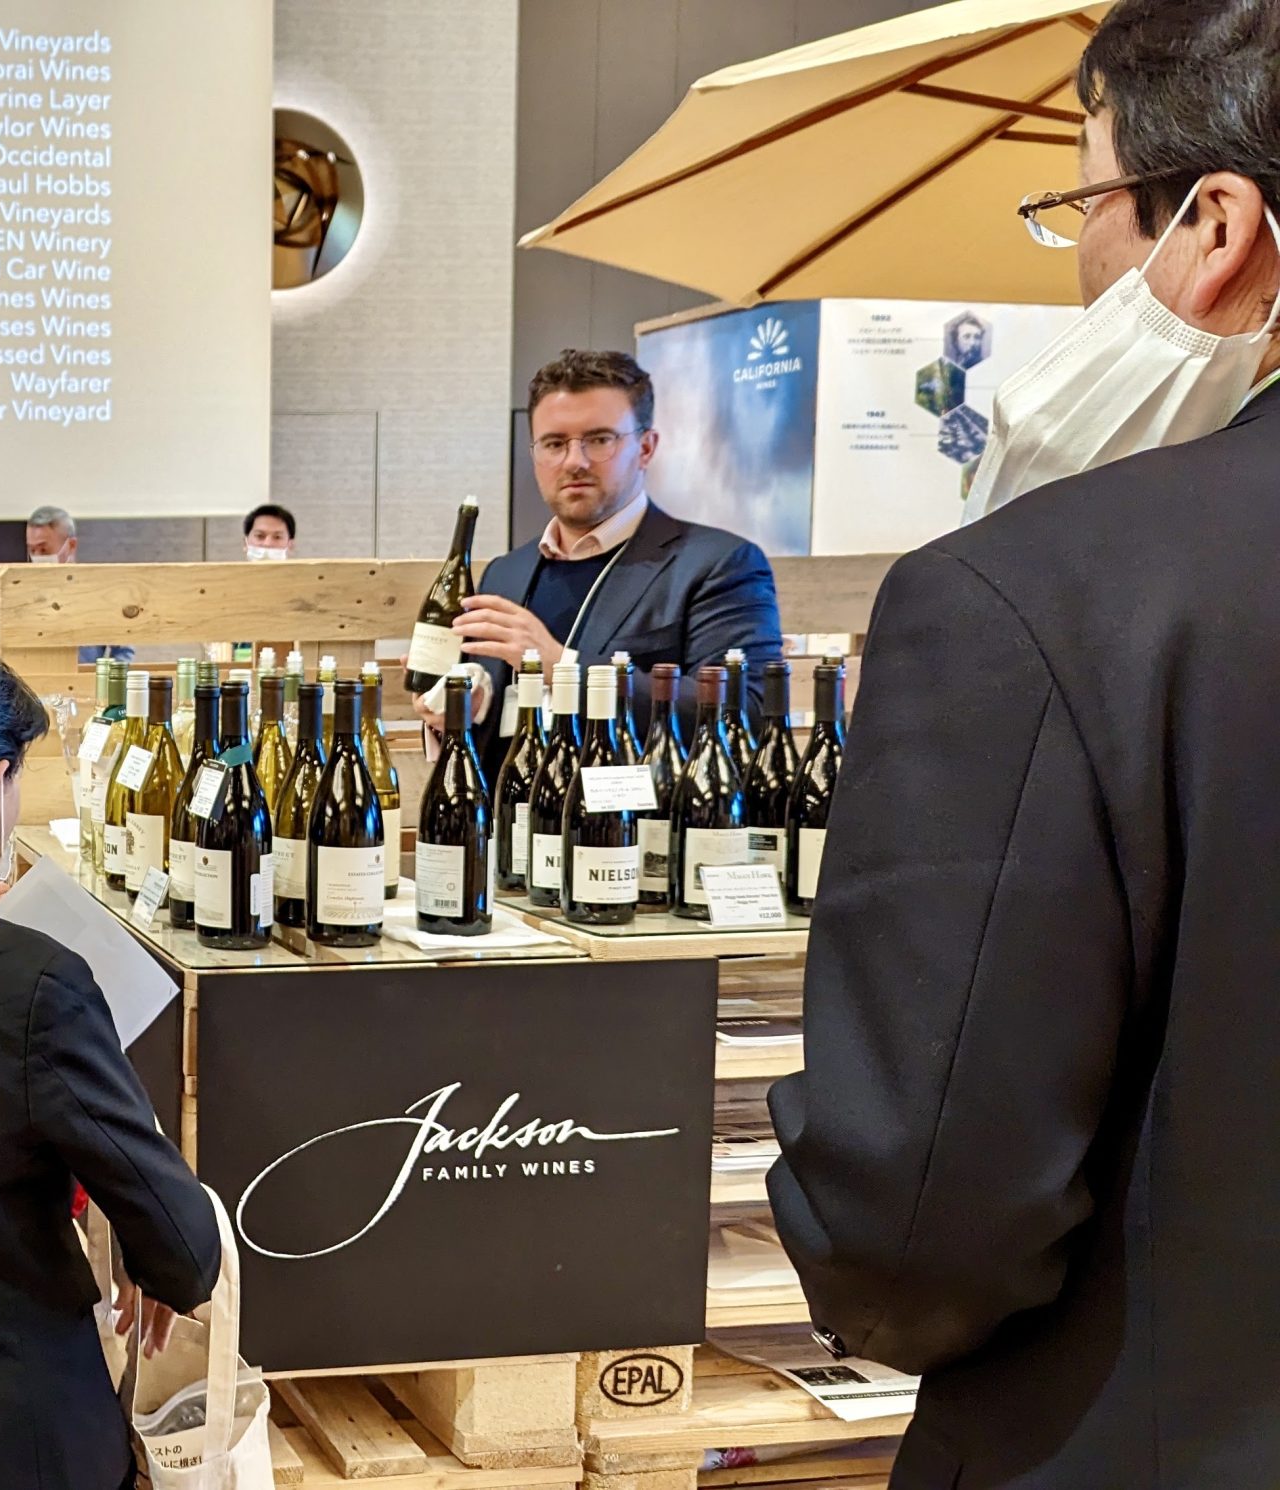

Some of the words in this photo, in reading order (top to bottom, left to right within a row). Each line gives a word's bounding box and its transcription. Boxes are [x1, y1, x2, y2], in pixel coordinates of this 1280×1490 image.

[40, 58, 111, 81] Wines
[49, 89, 110, 115] Layer
[41, 117, 111, 138] Wines
[35, 176, 111, 196] Hobbs
[0, 202, 111, 228] Vineyards
[31, 231, 111, 256] Winery
[6, 259, 45, 280] Car
[52, 261, 111, 280] Wine
[42, 288, 110, 308] Wines
[43, 316, 111, 337] Wines
[50, 345, 111, 366] Vines
[733, 357, 802, 383] CALIFORNIA
[11, 371, 111, 399] Wayfarer
[12, 400, 112, 426] Vineyard
[236, 1082, 680, 1259] Jackson
[422, 1164, 508, 1181] FAMILY
[521, 1159, 597, 1177] WINES
[612, 1364, 673, 1396] EPAL
